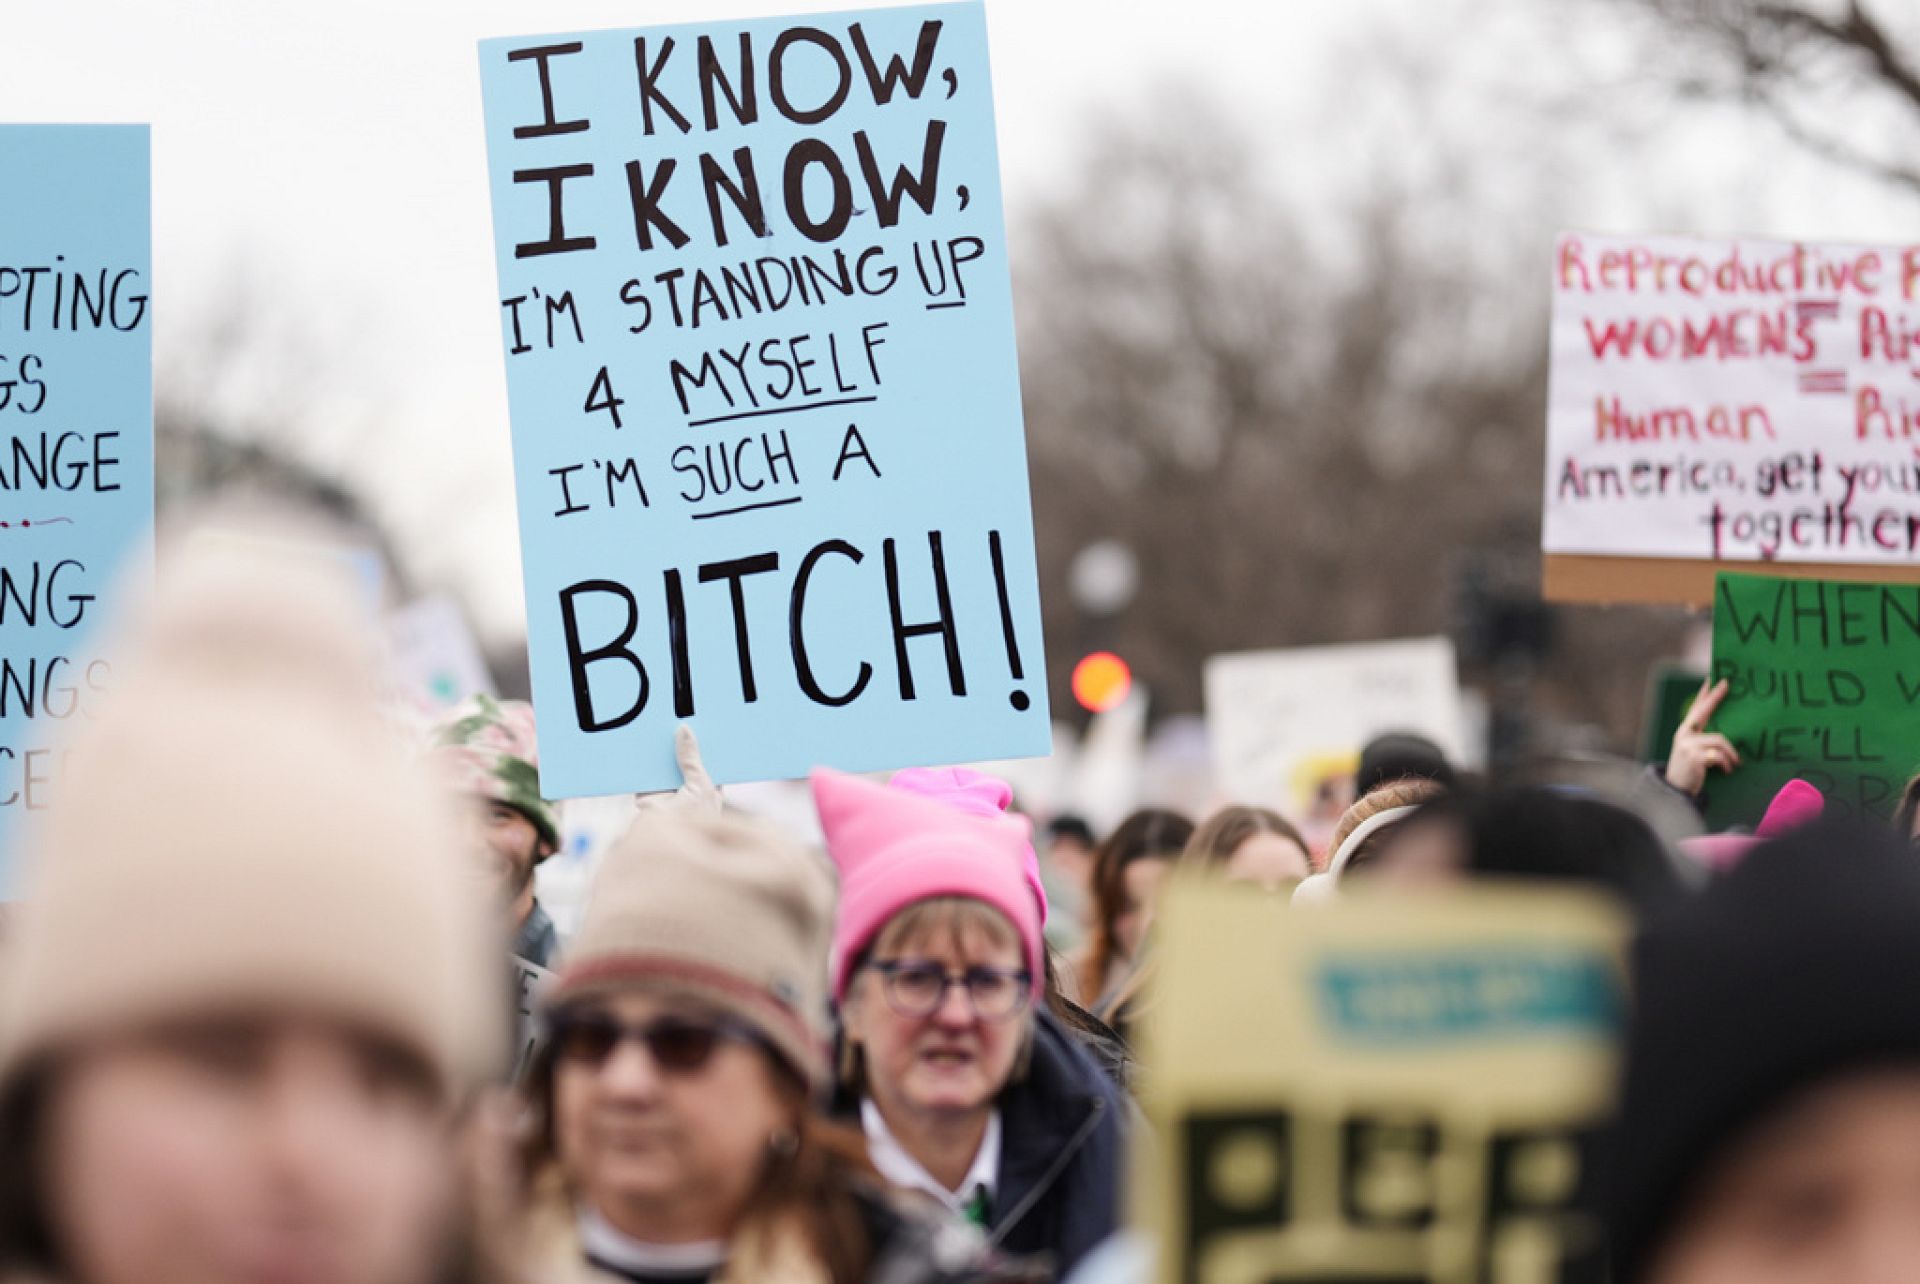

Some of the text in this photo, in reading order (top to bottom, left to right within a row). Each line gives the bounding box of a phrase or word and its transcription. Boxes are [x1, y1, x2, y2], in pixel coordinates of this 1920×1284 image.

[507, 20, 958, 140] I KNOW,
[512, 119, 970, 260] I KNOW,
[501, 236, 985, 355] I'M STANDING UP
[1559, 240, 1883, 297] Reproductive
[584, 322, 889, 430] 4 MYSELF
[1860, 305, 1920, 379] Ri
[0, 431, 121, 492] NGE
[1594, 384, 1920, 458] Human Ri
[548, 423, 882, 517] I'M SUCH A
[1757, 450, 1824, 497] get
[558, 529, 1031, 734] BITCH!
